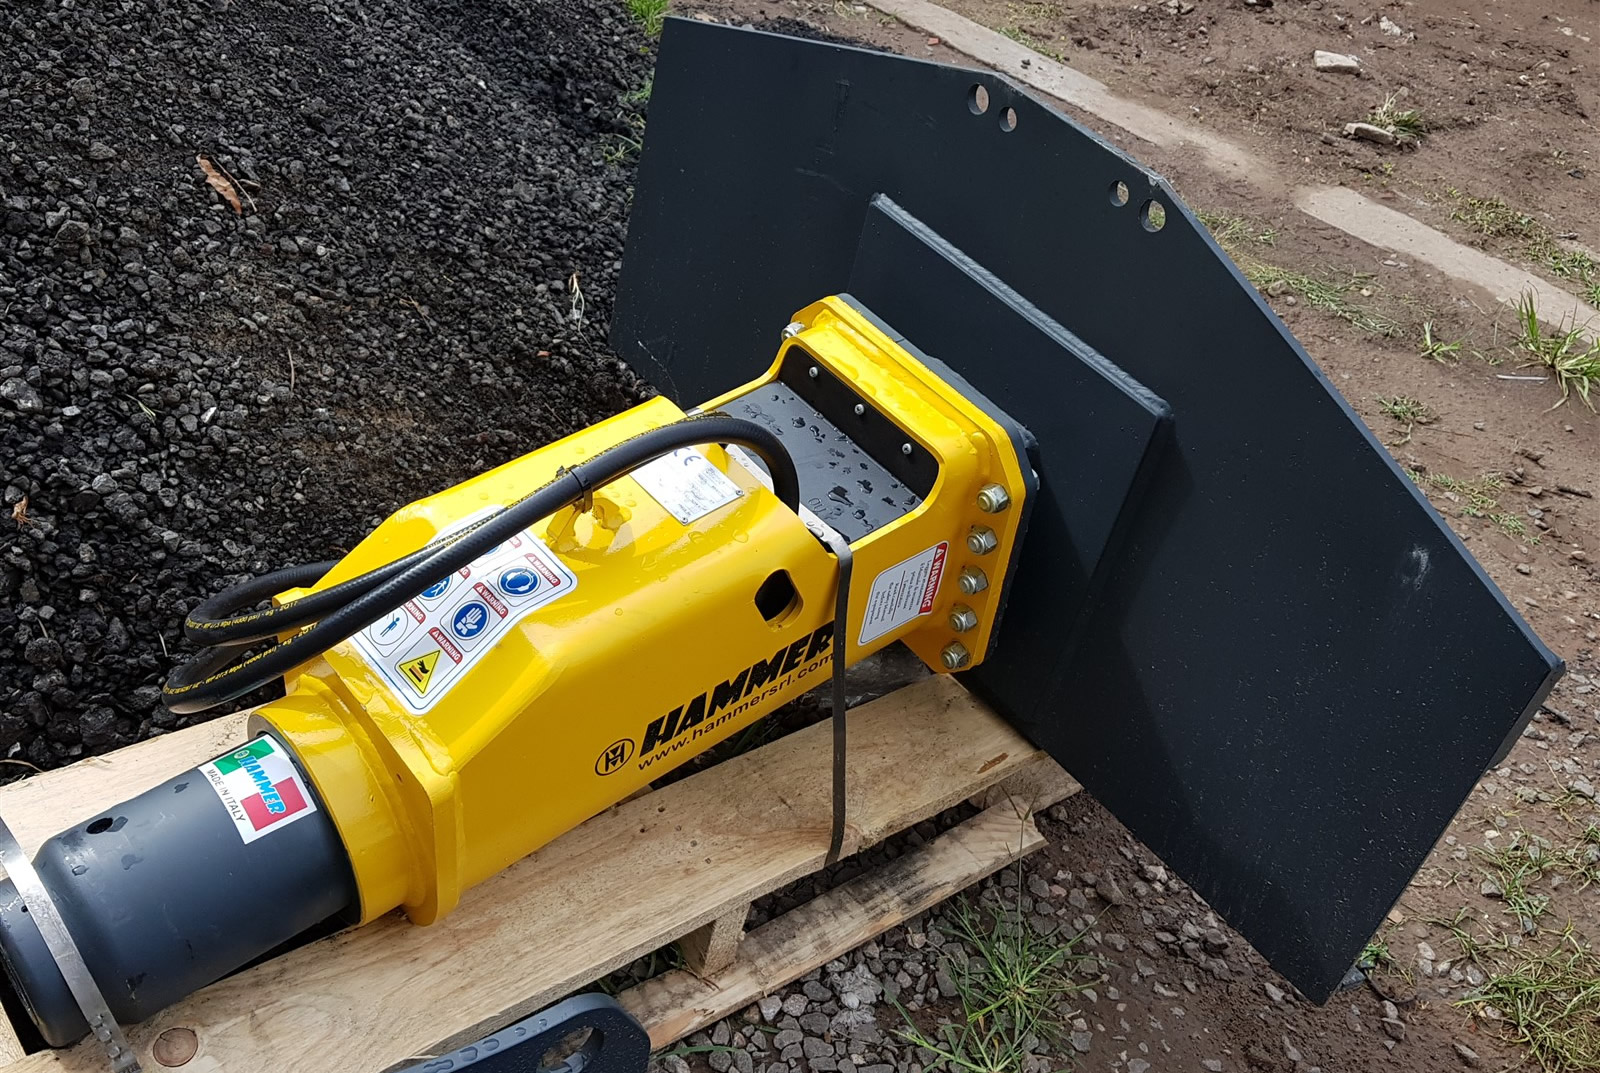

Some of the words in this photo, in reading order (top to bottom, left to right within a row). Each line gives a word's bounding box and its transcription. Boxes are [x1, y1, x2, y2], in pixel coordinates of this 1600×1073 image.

[533, 560, 559, 584] WARNING
[922, 559, 942, 608] WARNING
[482, 588, 506, 615] WARNING
[437, 634, 461, 661] WARNING
[638, 620, 834, 758] HAMMER
[638, 653, 834, 771] www.hammersrl.com
[206, 768, 223, 787] MADE
[220, 786, 230, 796] IN
[225, 795, 246, 821] ITALY
[239, 755, 286, 814] HAMMER
